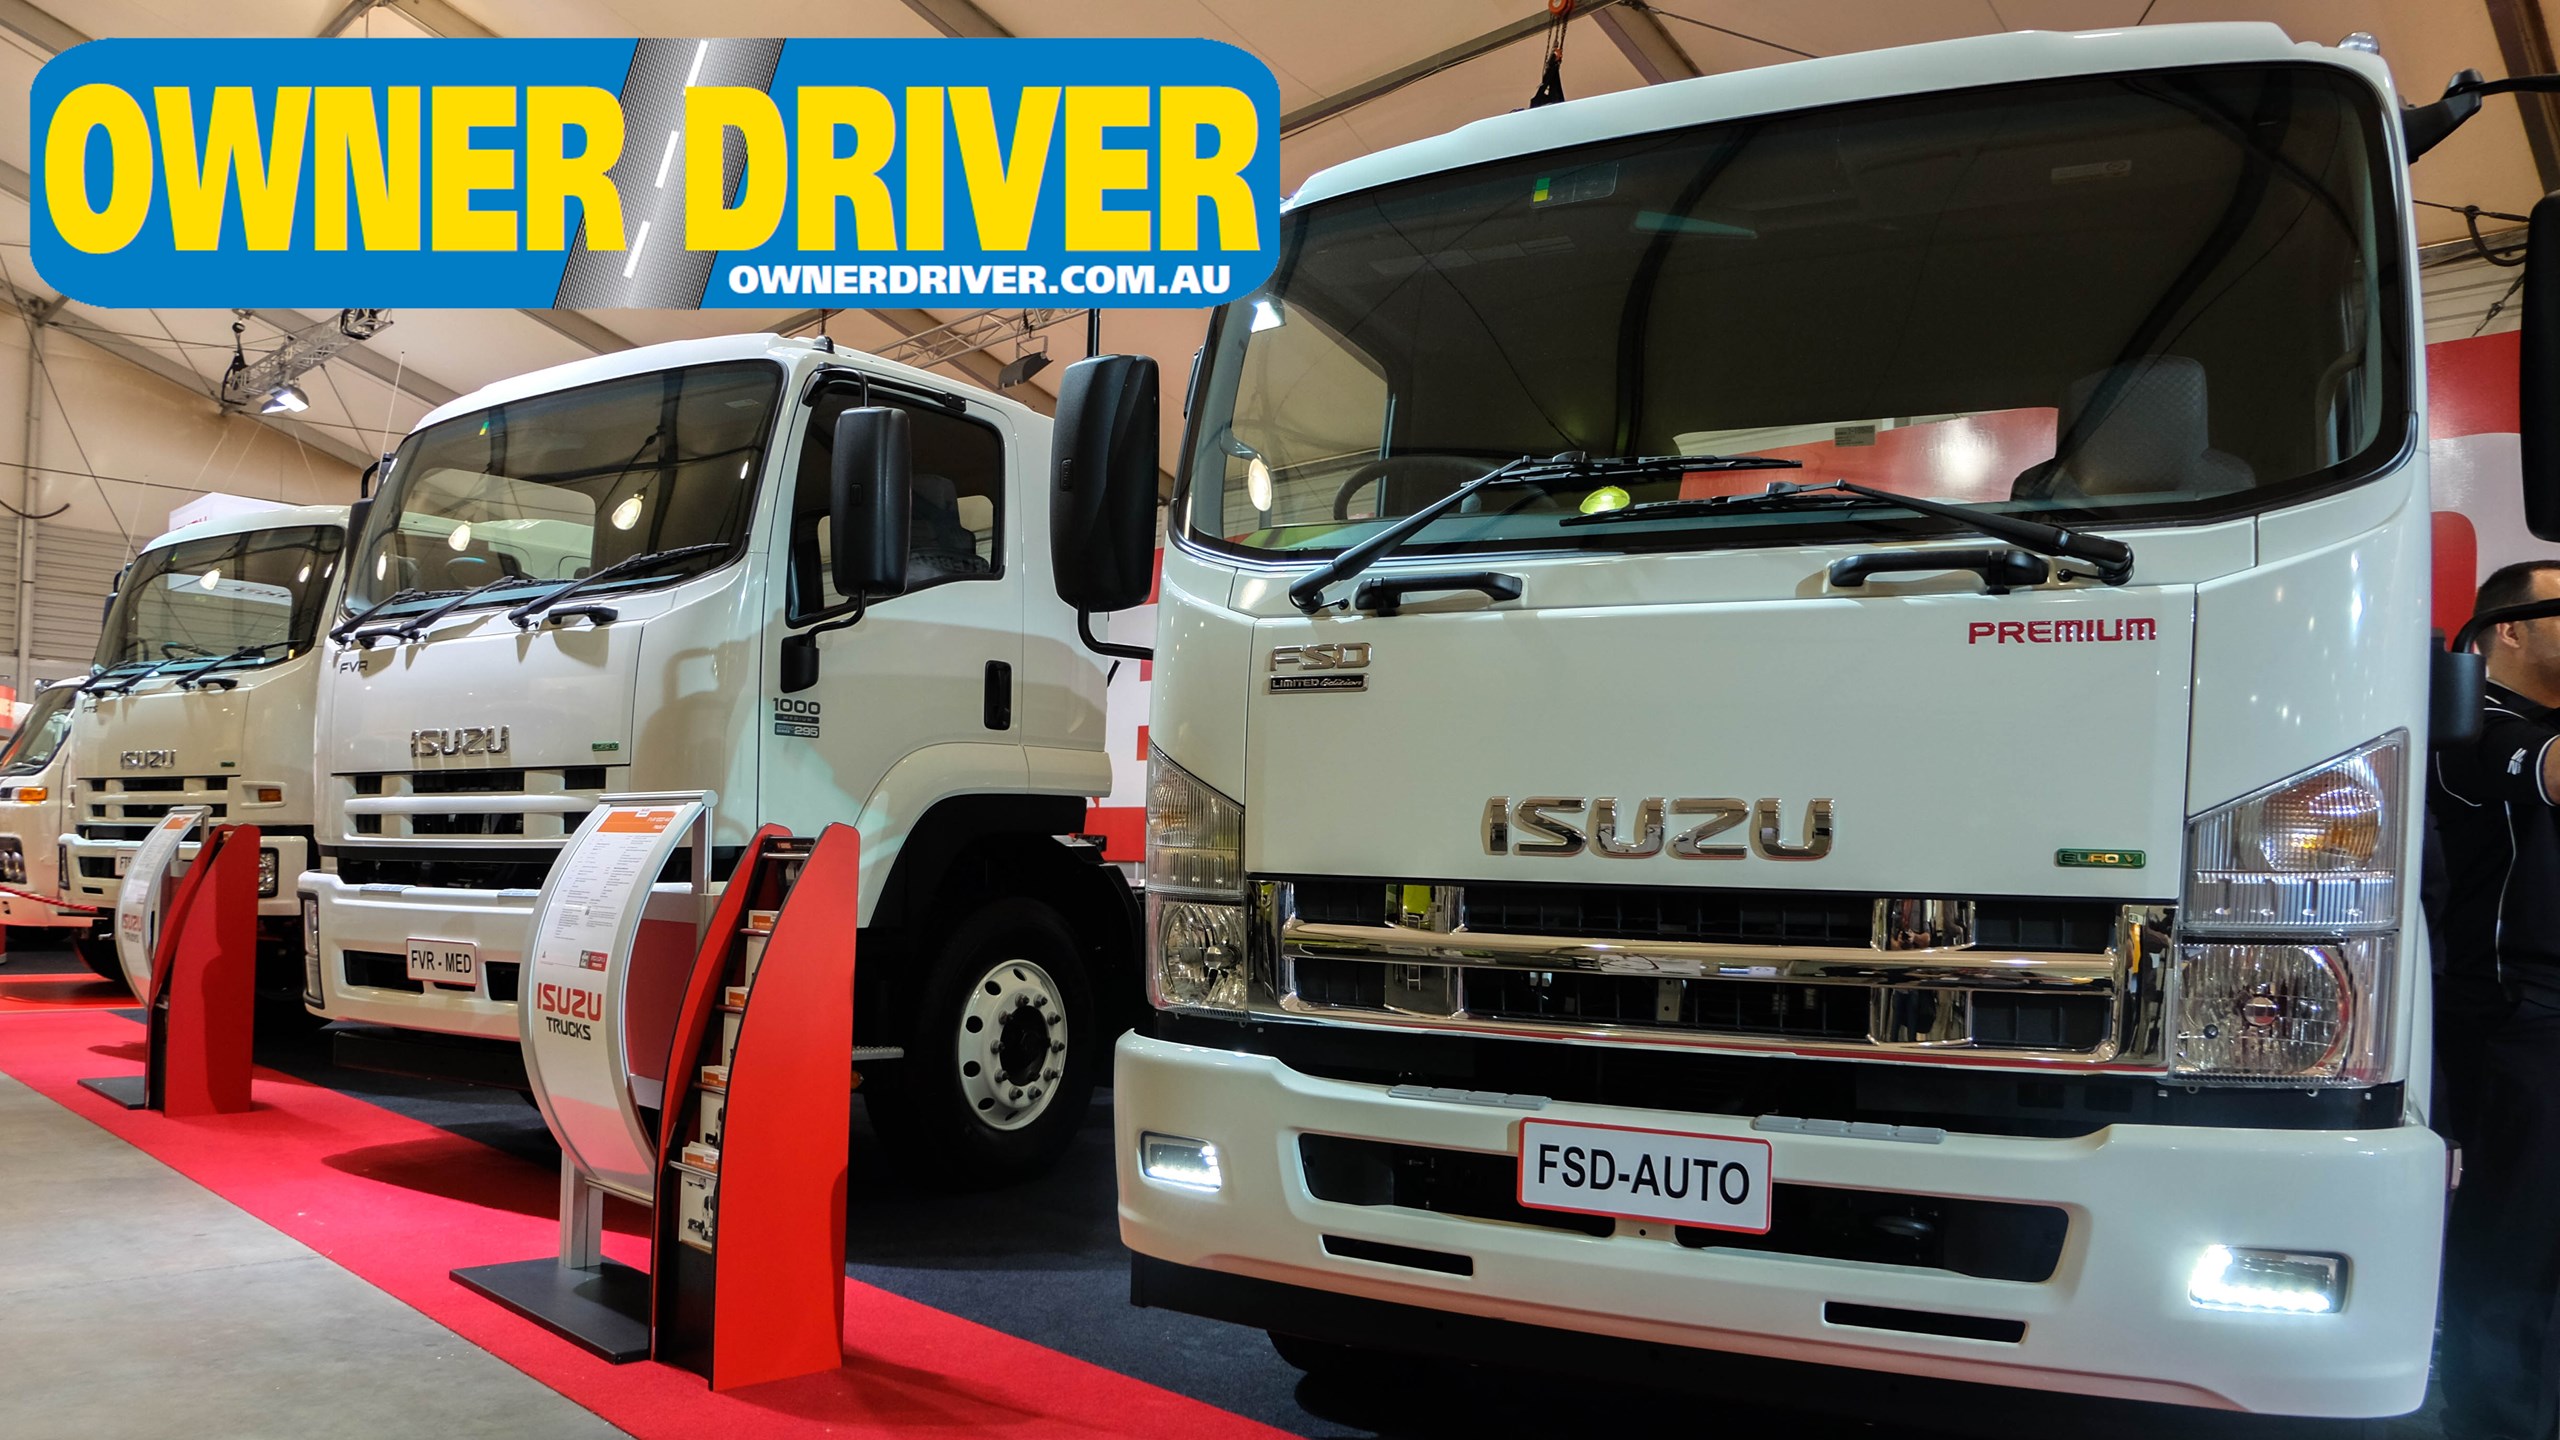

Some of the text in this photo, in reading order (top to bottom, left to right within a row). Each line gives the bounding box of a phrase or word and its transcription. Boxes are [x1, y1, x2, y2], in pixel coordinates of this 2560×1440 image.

[1968, 617, 2157, 645] PREMIUM
[339, 660, 369, 674] FVR
[1270, 642, 1372, 672] FSD
[1272, 679, 1320, 688] LIMITED
[772, 697, 821, 715] 1000
[411, 724, 511, 758] ISUZU
[793, 725, 819, 737] 295
[120, 749, 177, 769] ISUZU
[1488, 796, 1834, 862] ISUZU
[2060, 852, 2119, 865] EURO
[411, 949, 435, 971] FVR
[445, 952, 472, 974] MED
[537, 982, 602, 1022] ISUZU
[546, 1016, 592, 1041] TRUCKS
[1538, 1143, 1750, 1206] FSD-AUTO
